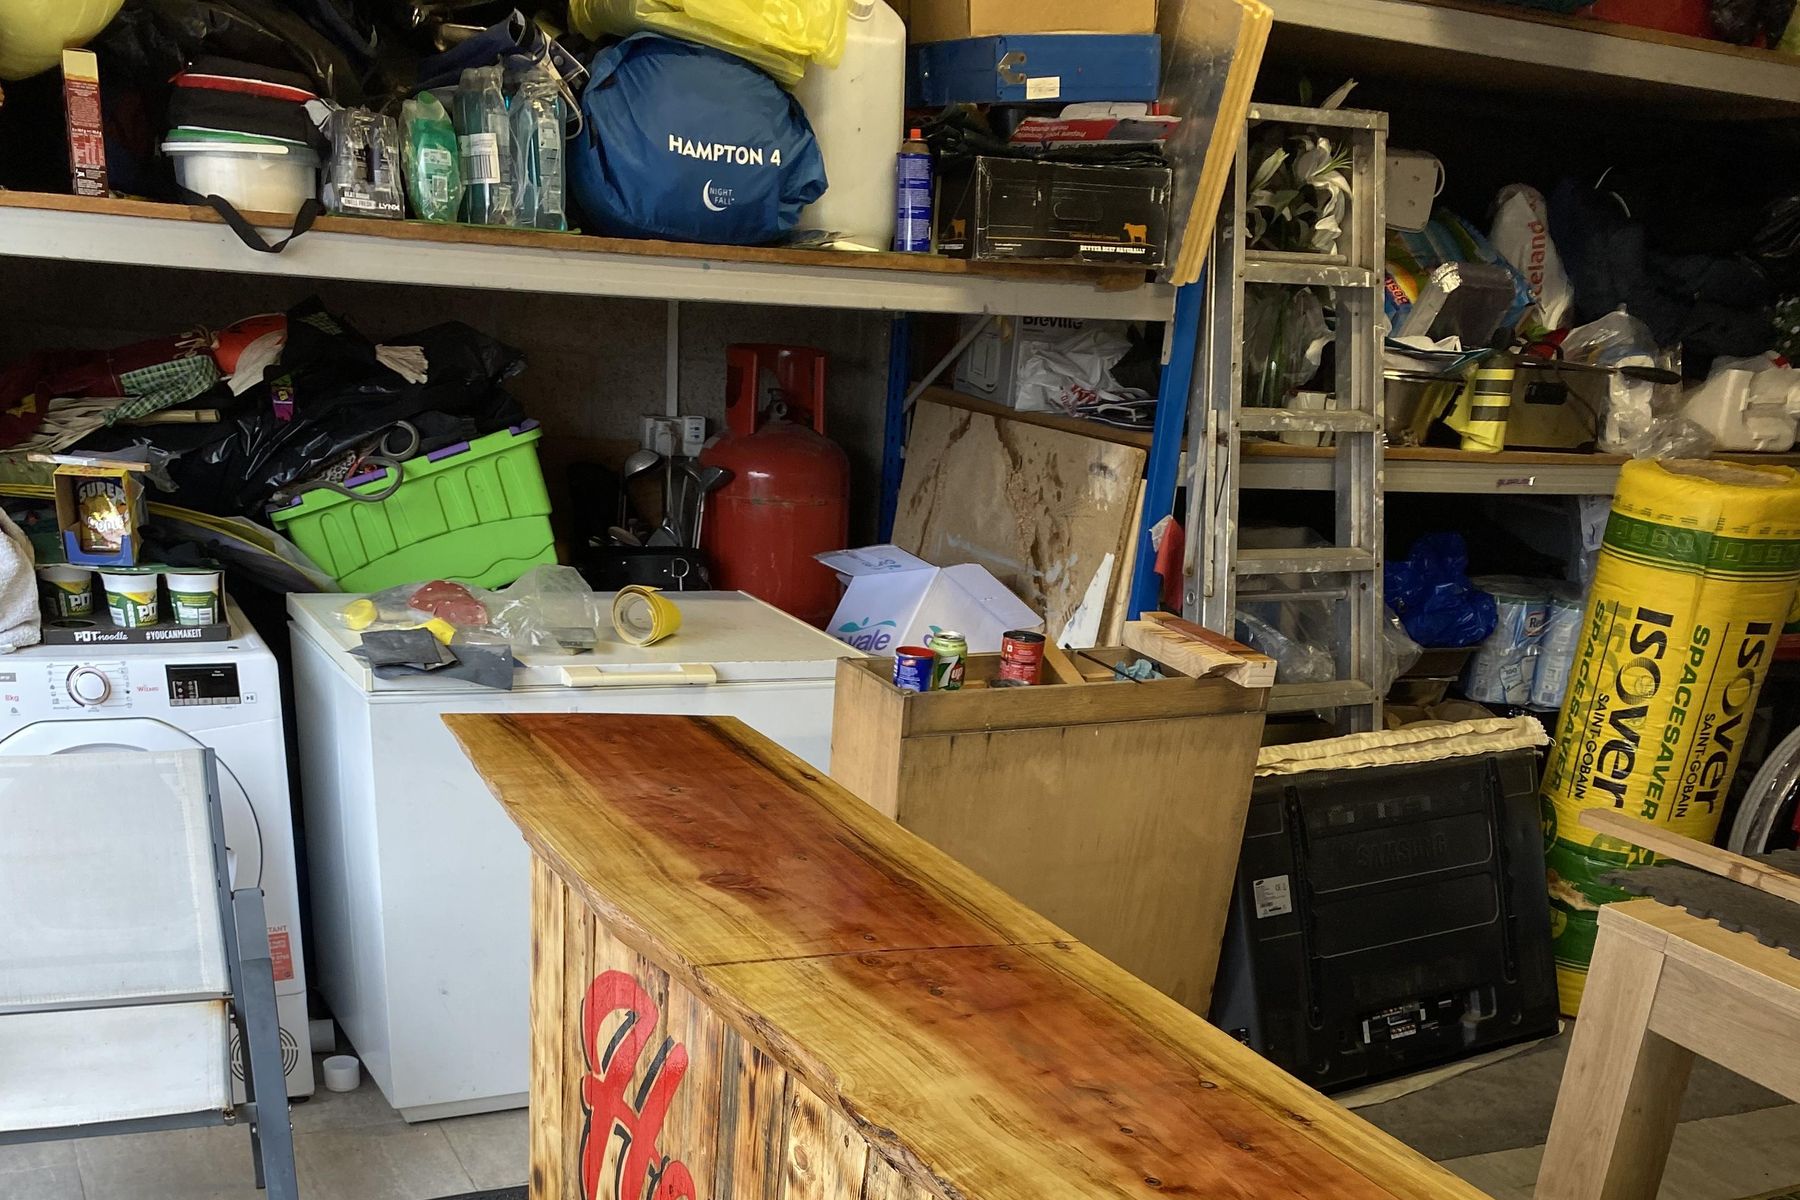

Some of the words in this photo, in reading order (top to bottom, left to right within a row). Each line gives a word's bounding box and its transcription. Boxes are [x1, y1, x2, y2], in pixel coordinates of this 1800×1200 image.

[668, 134, 763, 166] HAMPTON
[770, 149, 781, 167] 4
[378, 202, 401, 211] LYNX
[709, 187, 733, 196] NIGHT
[714, 196, 732, 206] FALL
[1528, 220, 1546, 296] celand
[79, 481, 126, 504] SUPER
[74, 631, 100, 643] POT
[146, 629, 202, 641] #YOUCANMAKEIT
[1552, 600, 1606, 791] SPACESAVER
[1641, 624, 1711, 821] SPACESAVER
[1574, 693, 1609, 800] SAINT-GOBAIN
[1675, 713, 1716, 818] SAINT-GOBAIN
